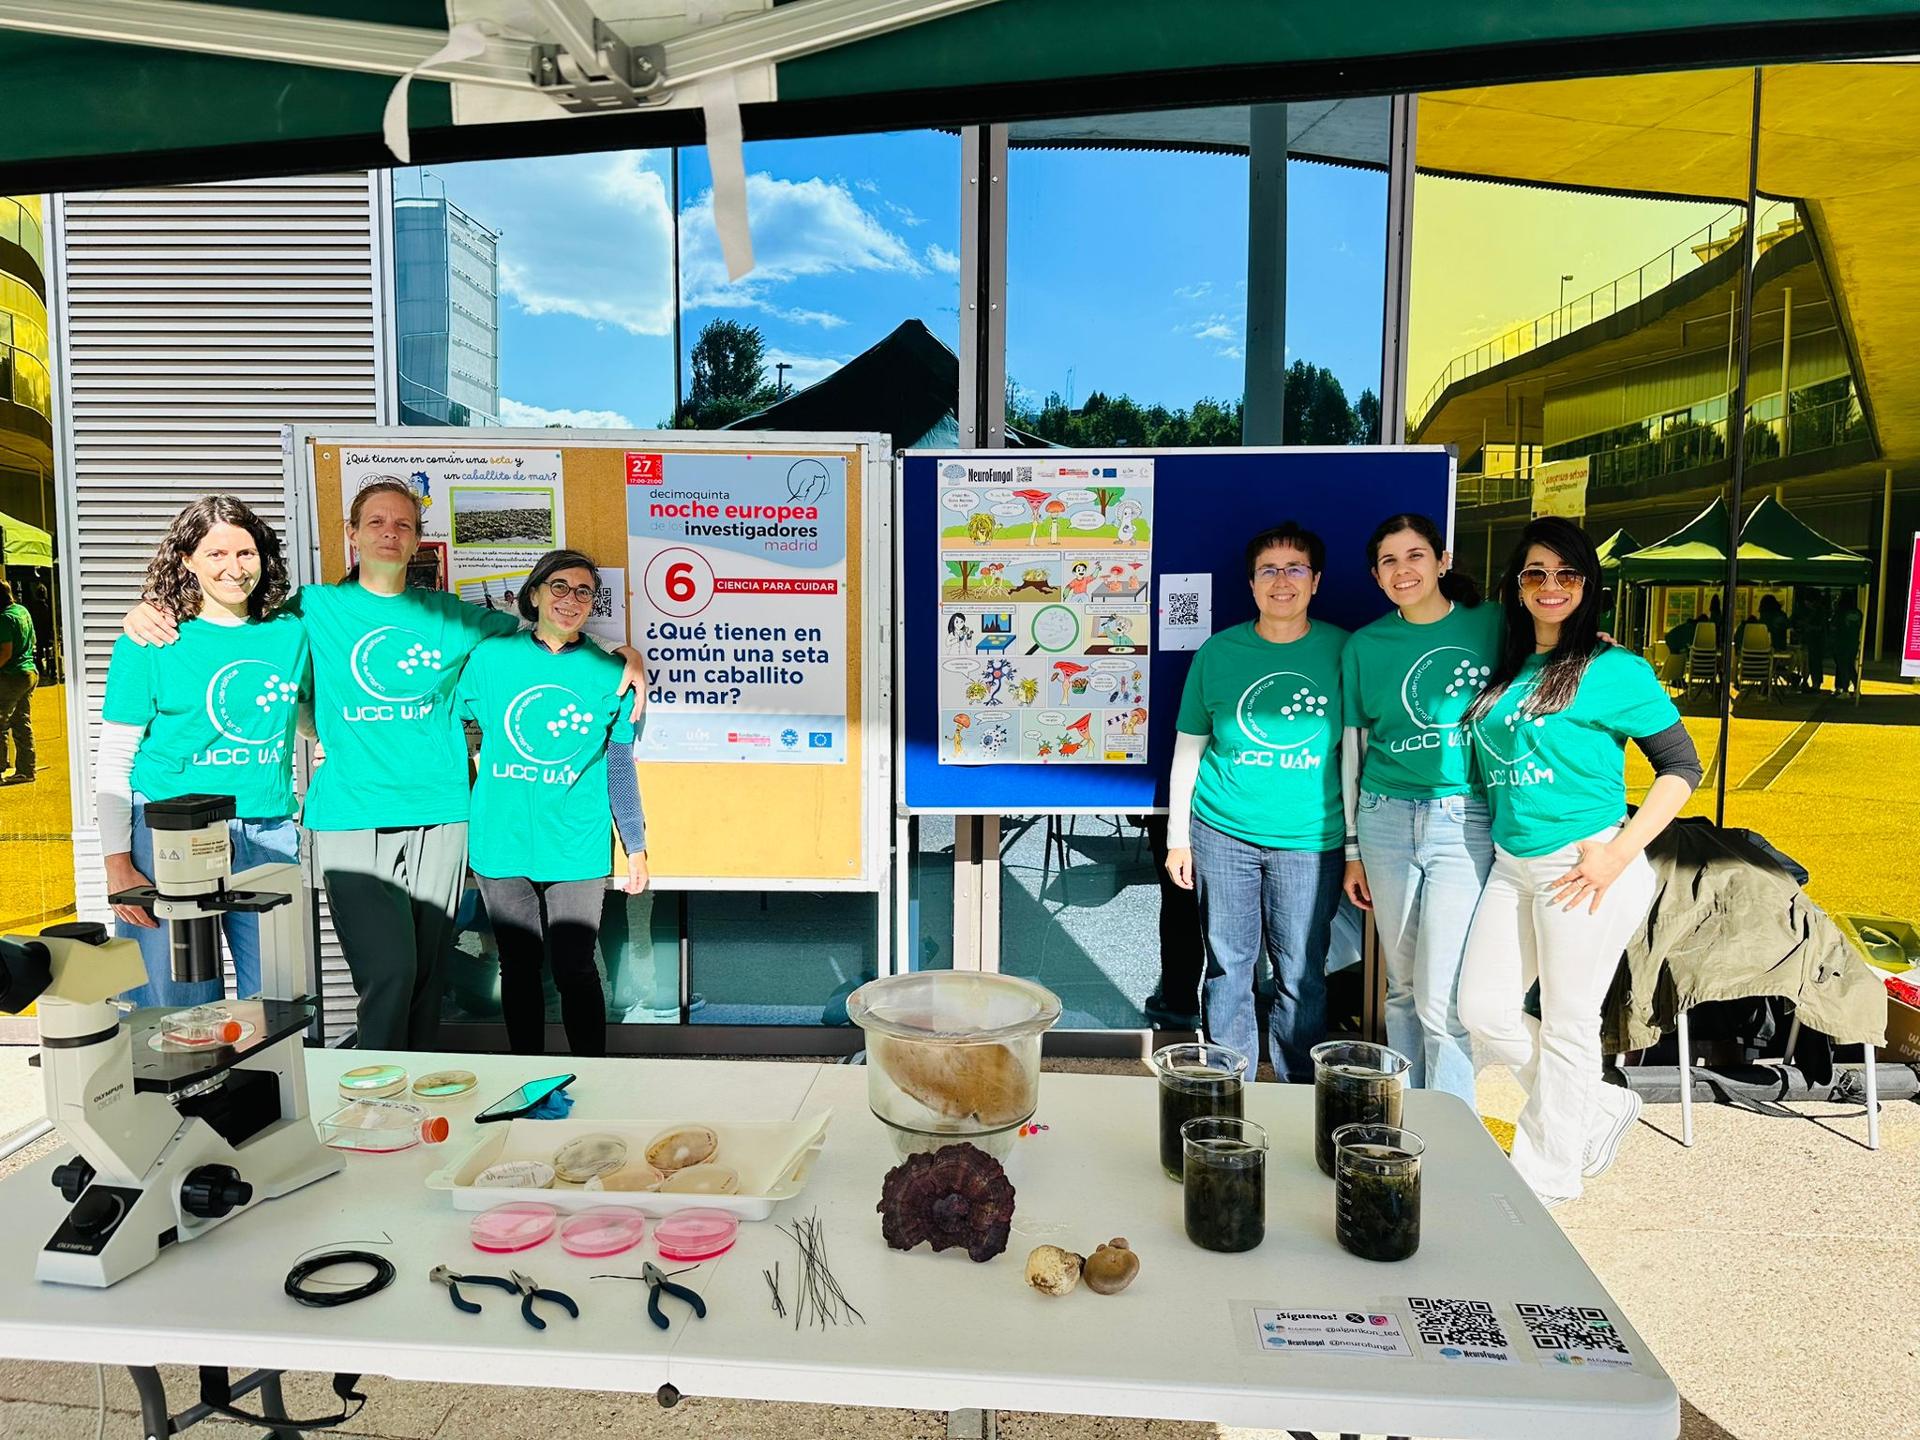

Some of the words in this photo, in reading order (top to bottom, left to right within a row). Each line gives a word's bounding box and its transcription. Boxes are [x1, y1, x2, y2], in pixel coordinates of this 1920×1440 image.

[346, 453, 371, 465] ¿Qué
[372, 454, 408, 464] tienen
[426, 452, 464, 464] común
[490, 456, 513, 465] seta
[515, 457, 524, 467] y
[632, 460, 651, 473] 27
[461, 469, 511, 481] caballito
[513, 471, 526, 481] de
[528, 472, 557, 481] mar?
[968, 468, 1014, 484] NeuroFungal
[649, 488, 730, 500] decimoquinta
[650, 501, 719, 518] noche
[725, 505, 818, 523] europea
[685, 520, 818, 540] investigadores
[764, 539, 818, 552] madrid
[664, 562, 697, 602] 6
[716, 580, 760, 591] CIENCIA
[762, 581, 791, 591] PARA
[794, 581, 835, 592] CUIDAR
[646, 622, 707, 641] ¿Qué
[714, 623, 786, 642] tienen
[794, 627, 821, 642] en
[647, 644, 725, 662] común
[733, 648, 774, 663] una
[782, 648, 829, 664] seta
[647, 669, 659, 686] y
[668, 668, 696, 683] un
[703, 666, 804, 684] caballito
[648, 686, 676, 704] de
[684, 687, 741, 704] mar?
[343, 705, 394, 721] UCC
[1391, 732, 1441, 753] UCC
[193, 748, 250, 765] UCC
[258, 740, 285, 765] UA
[492, 763, 539, 782] UCC
[93, 1083, 124, 1103] OLYMPUS
[56, 1242, 93, 1251] OLYMPUS
[1276, 1312, 1338, 1321] ¡Síguenos!
[1463, 1350, 1508, 1361] NeuroFungal
